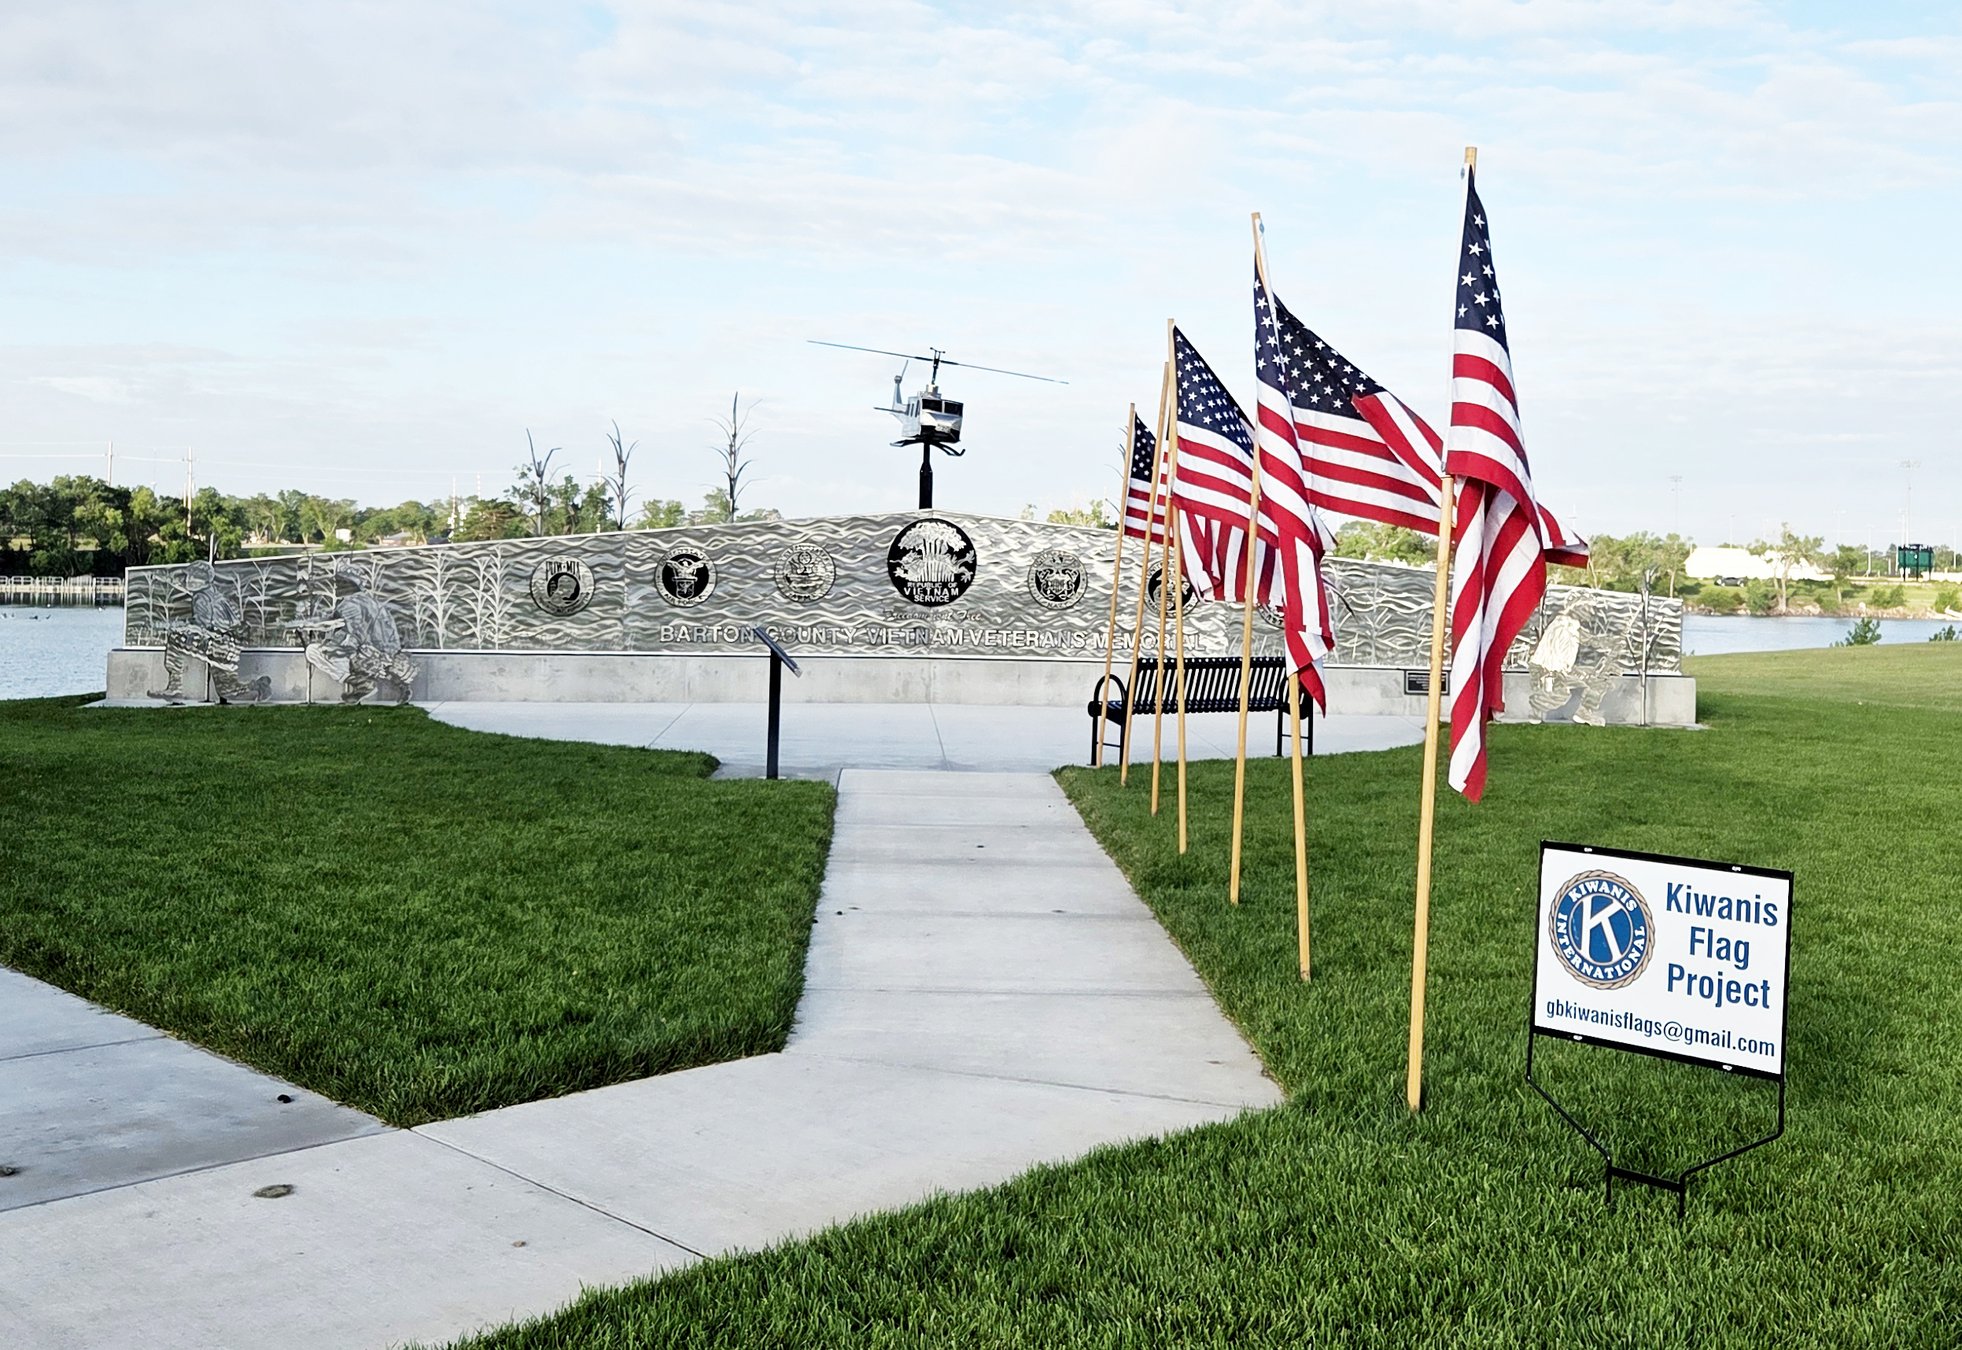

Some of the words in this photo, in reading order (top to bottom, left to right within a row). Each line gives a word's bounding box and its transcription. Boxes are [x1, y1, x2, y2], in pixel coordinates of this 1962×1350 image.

[903, 588, 959, 596] VIETNAM
[660, 625, 755, 644] BARTON
[766, 625, 857, 644] COUNTY
[866, 627, 964, 646] VIETNAM
[968, 629, 1087, 649] VETERANS
[1568, 880, 1638, 912] KIWANIS
[1666, 882, 1778, 926] Kiwanis
[1556, 912, 1646, 979] INTERNATIONAL
[1689, 926, 1750, 970] Flag
[1667, 963, 1770, 1009] Project
[1546, 999, 1775, 1057] gbkiwanisflags@gmail.com
